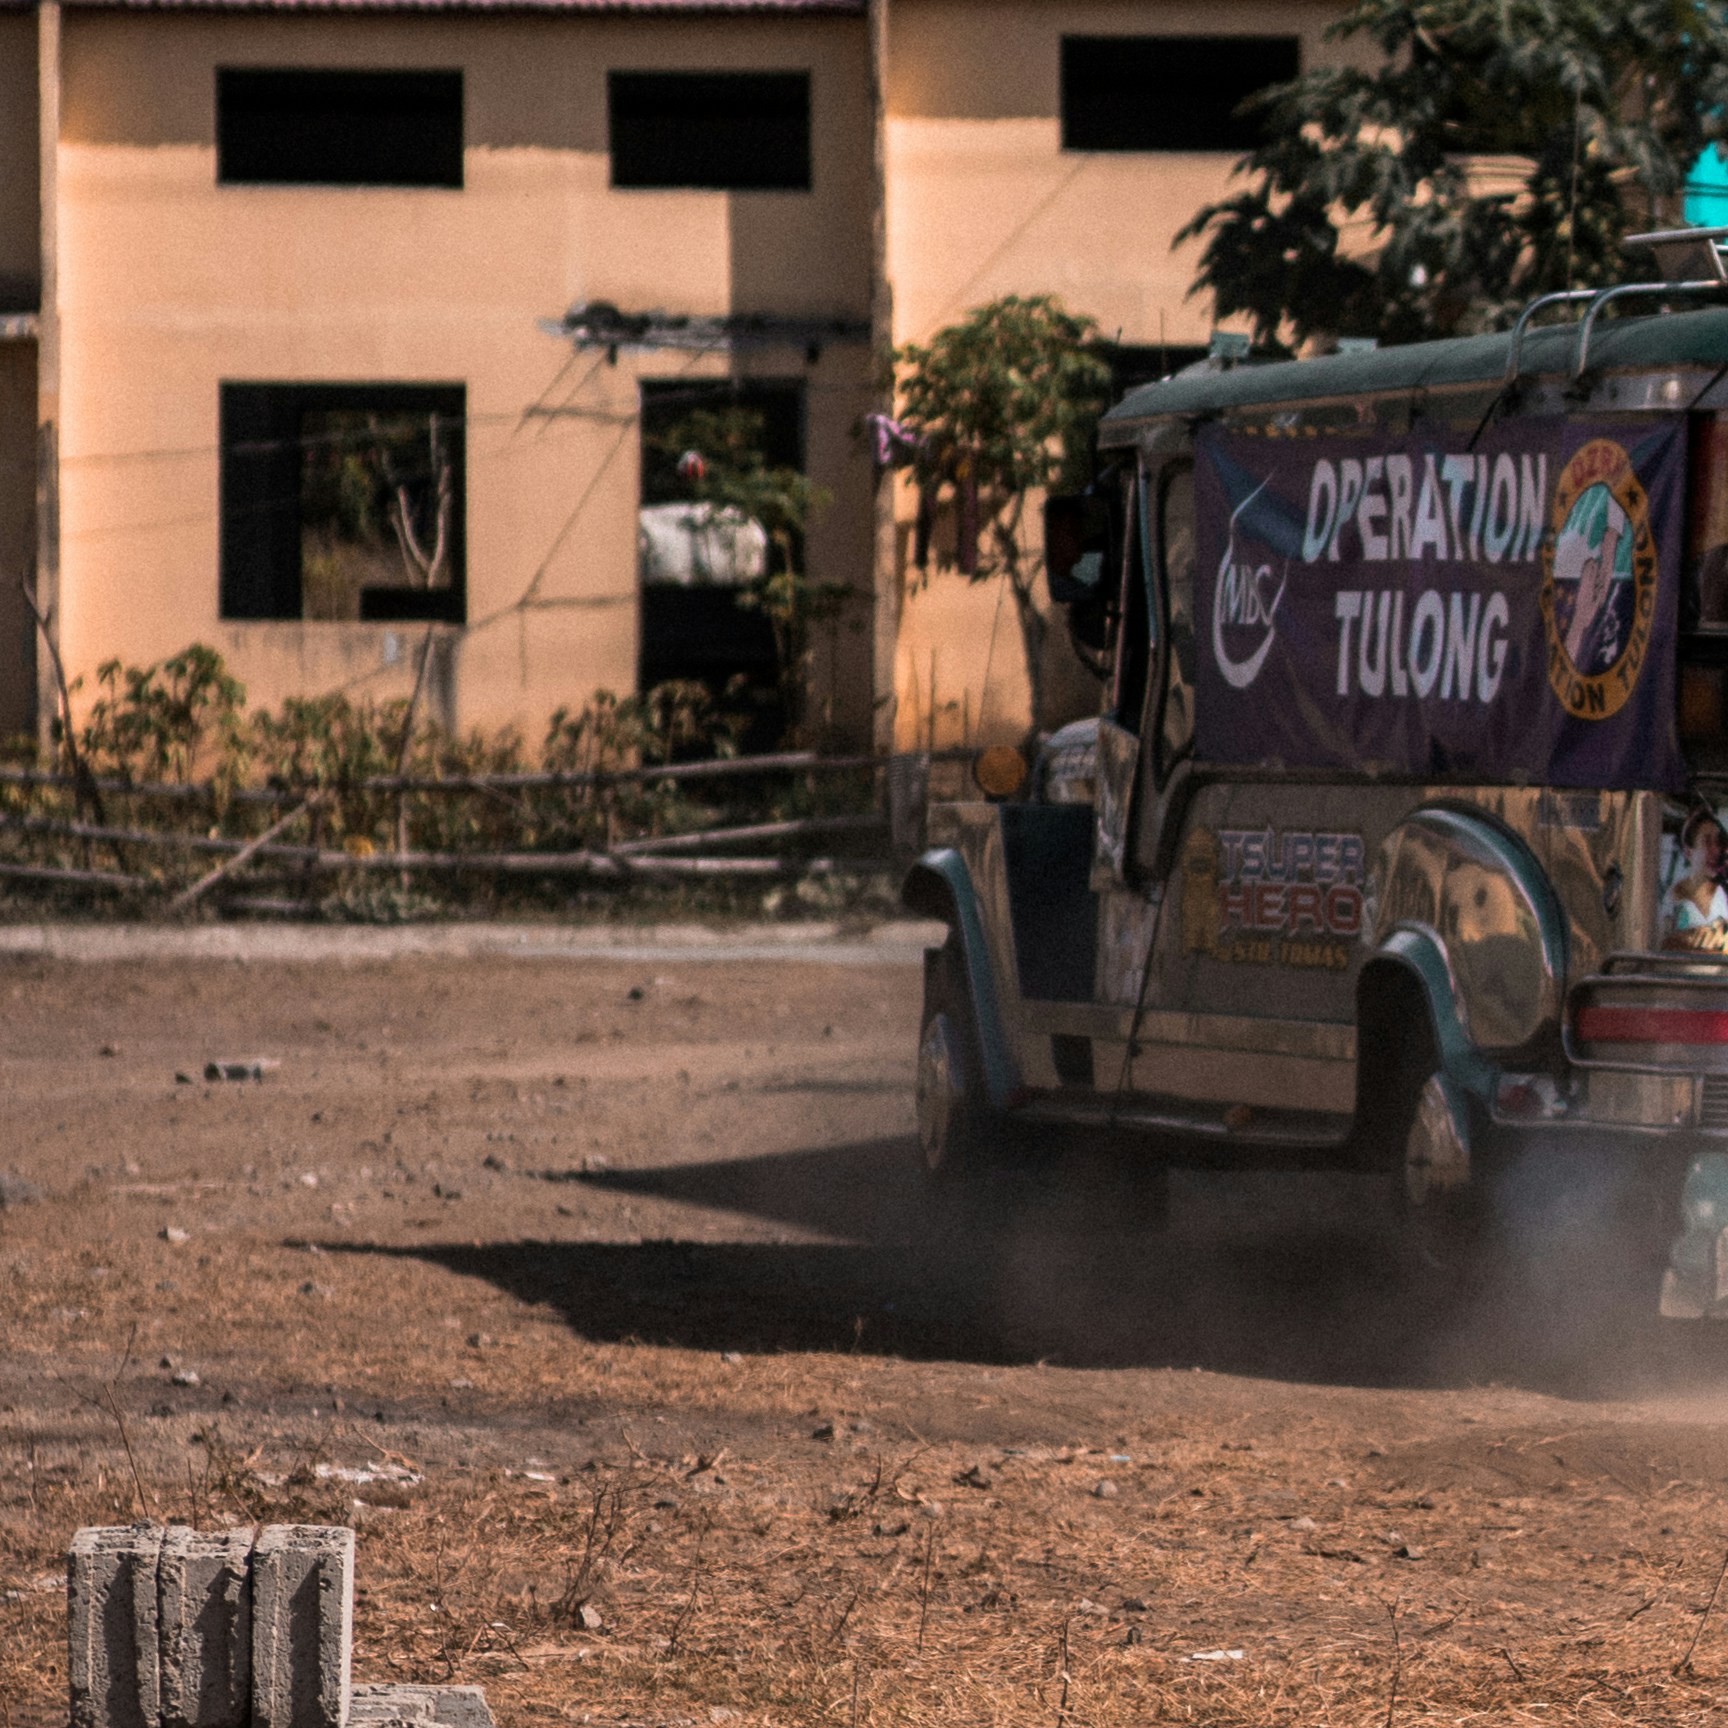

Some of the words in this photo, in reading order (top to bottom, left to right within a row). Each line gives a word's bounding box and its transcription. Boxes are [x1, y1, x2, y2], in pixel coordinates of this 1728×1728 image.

[1302, 452, 1548, 565] OPERATION
[1219, 563, 1272, 626] MBC
[1335, 589, 1510, 704] TULONG
[1218, 824, 1365, 885] TSUPER
[1218, 881, 1365, 936] HERO
